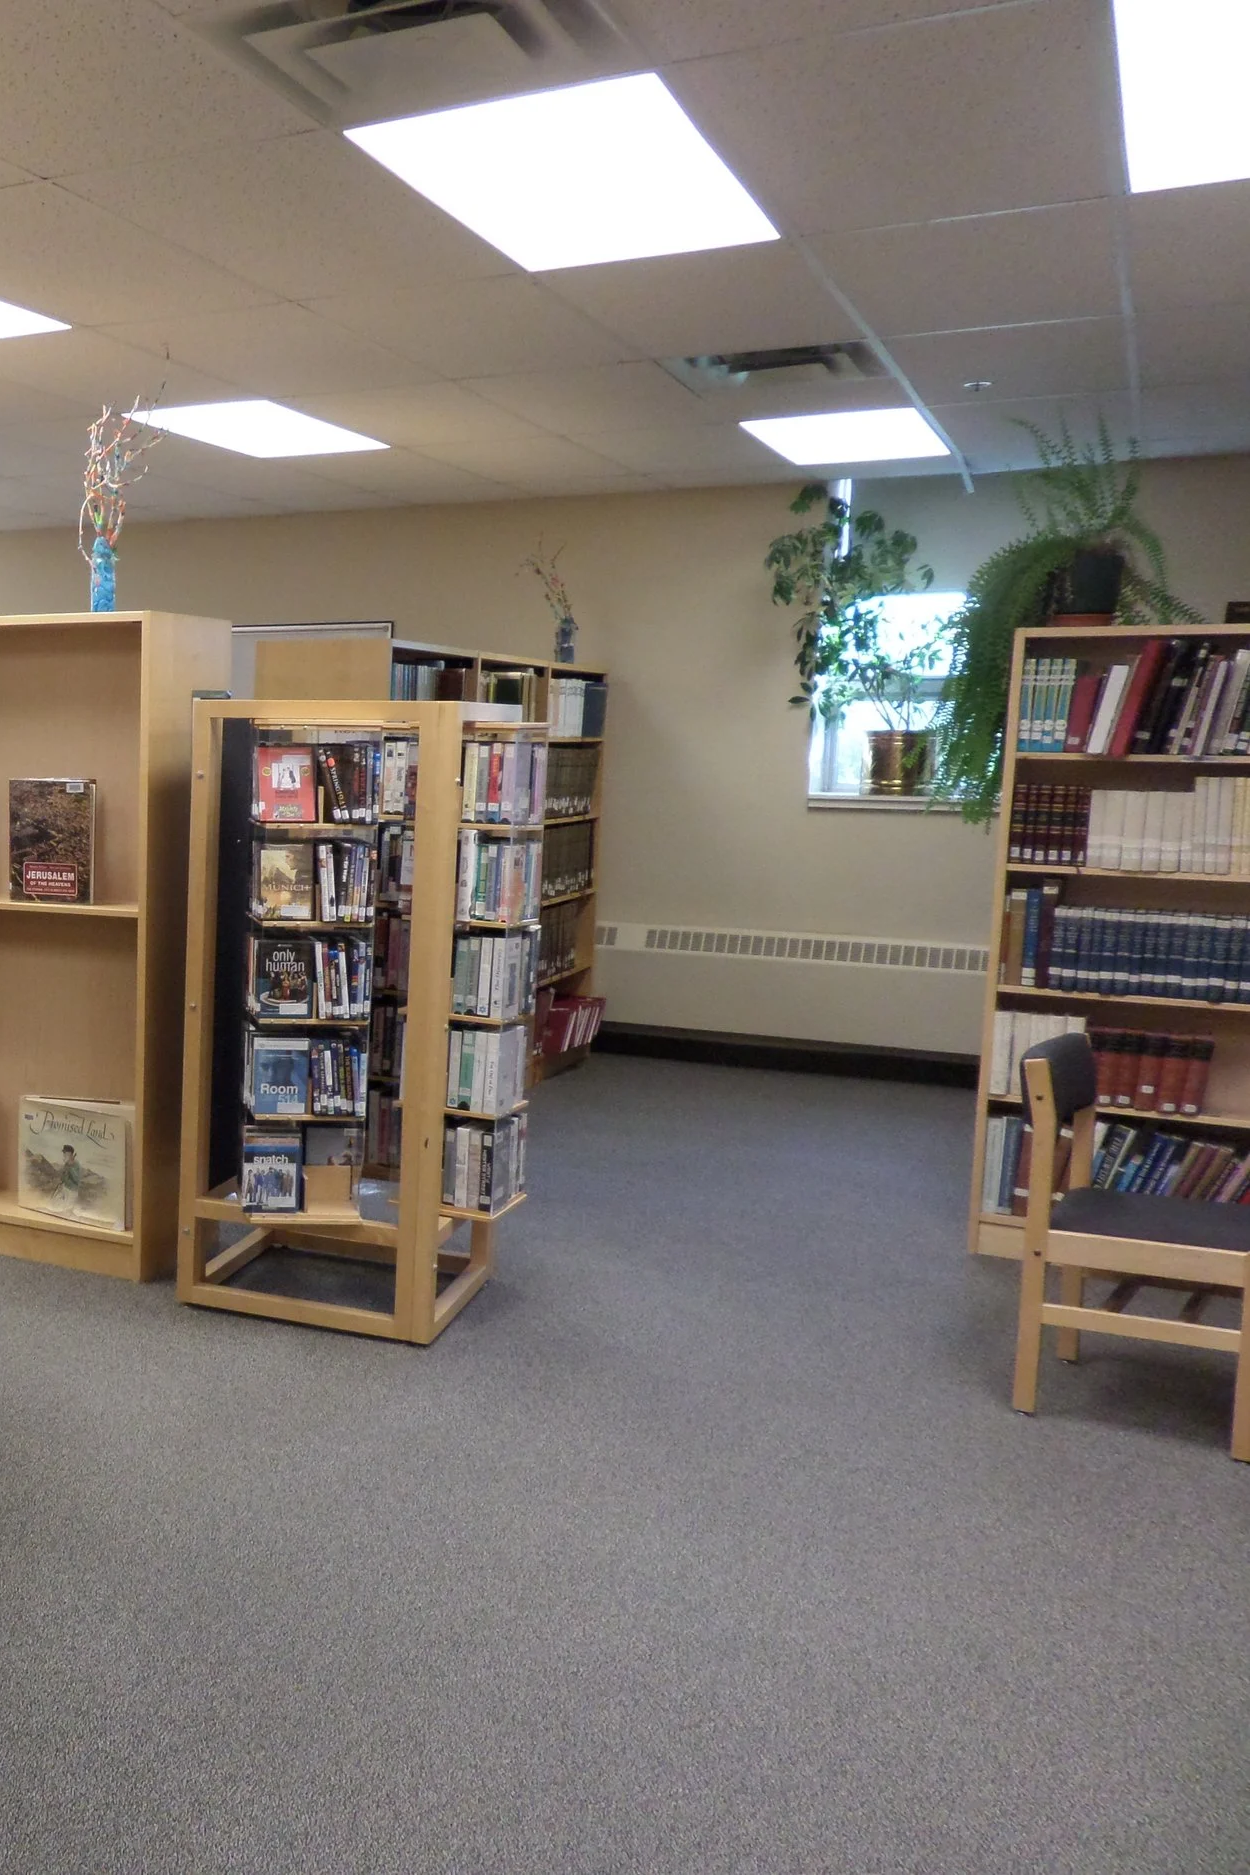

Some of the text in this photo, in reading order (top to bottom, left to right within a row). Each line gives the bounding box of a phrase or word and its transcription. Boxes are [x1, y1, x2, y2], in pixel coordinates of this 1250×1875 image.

[329, 766, 341, 792] SPRING
[26, 870, 75, 881] JERUSALEM
[262, 882, 312, 893] MUNICH
[272, 948, 296, 964] only
[265, 958, 305, 973] human
[259, 1082, 299, 1096] Room
[29, 1109, 85, 1136] Promised
[253, 1154, 289, 1166] snatch
